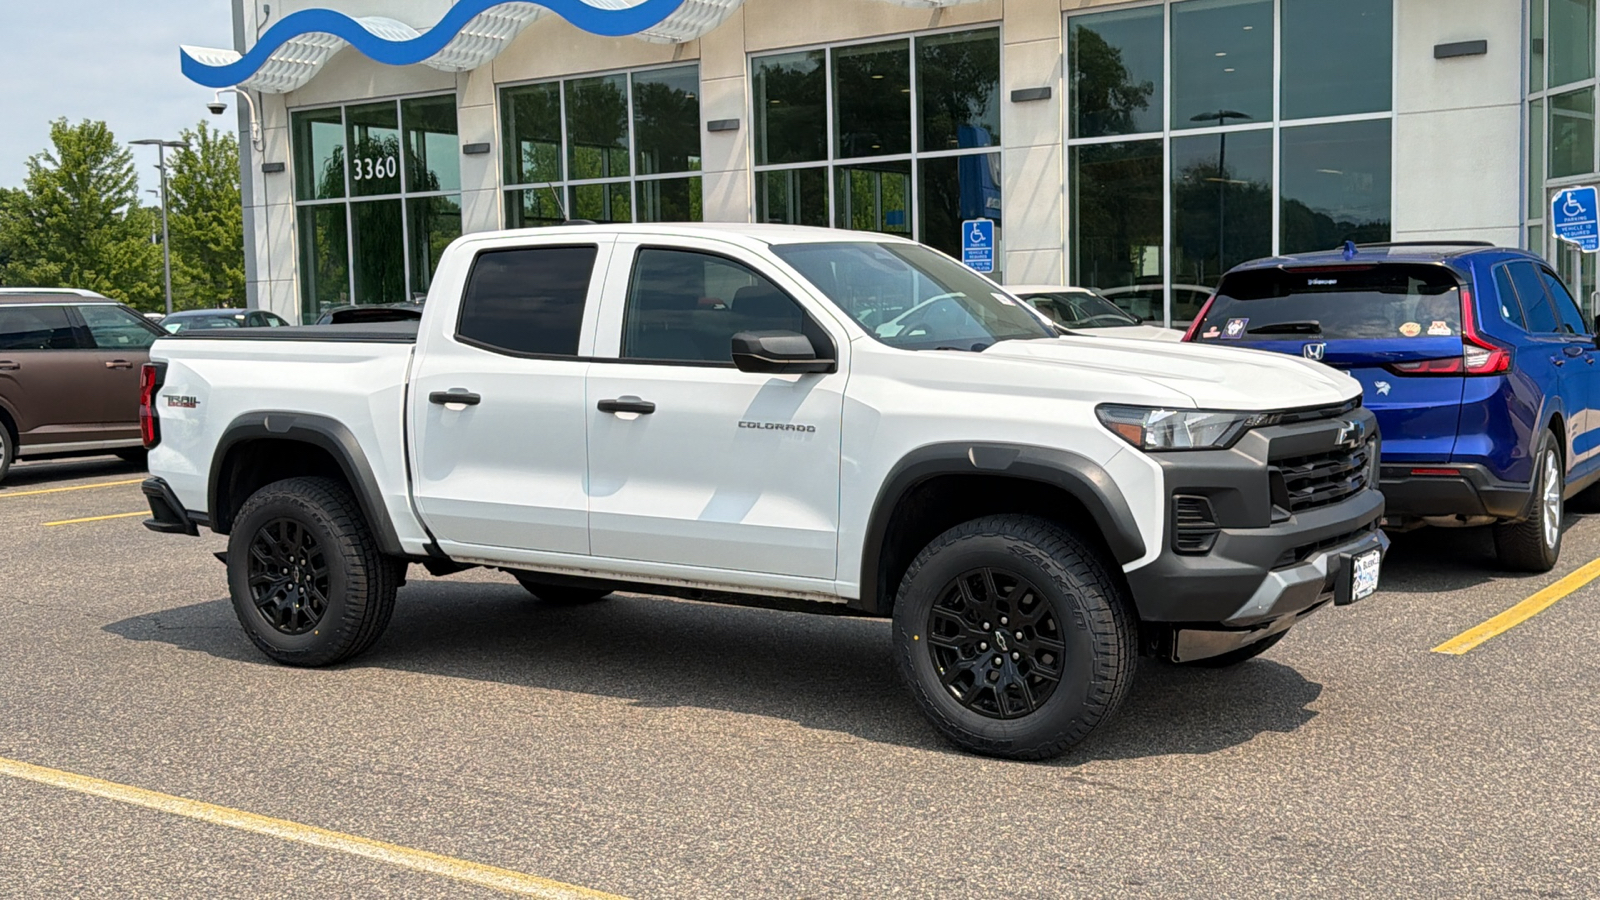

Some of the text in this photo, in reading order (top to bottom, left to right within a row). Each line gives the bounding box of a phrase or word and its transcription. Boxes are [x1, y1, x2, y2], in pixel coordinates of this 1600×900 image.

[353, 155, 397, 181] 3360
[162, 394, 201, 405] TRAIL
[738, 421, 816, 433] COLORADO
